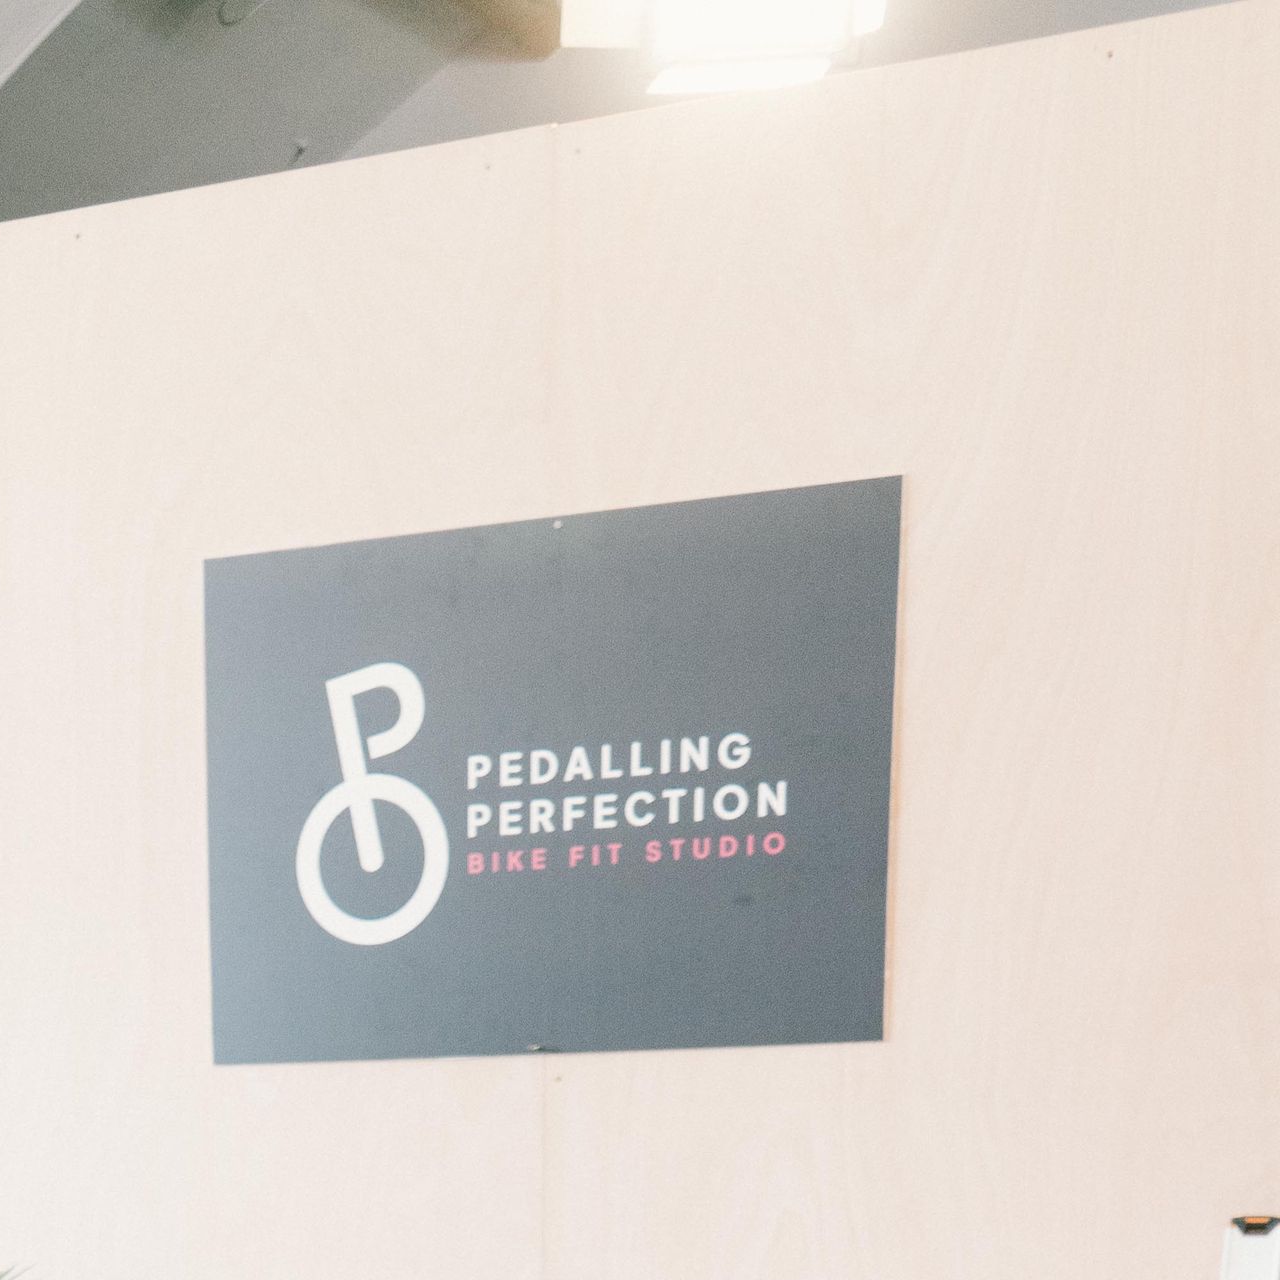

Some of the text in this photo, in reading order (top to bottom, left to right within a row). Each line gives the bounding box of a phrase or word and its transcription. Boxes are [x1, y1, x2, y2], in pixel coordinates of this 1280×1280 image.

[467, 733, 751, 790] PEDALLING
[467, 781, 787, 840] PERFECTION
[468, 832, 787, 875] BIKE FIT STUDIO
